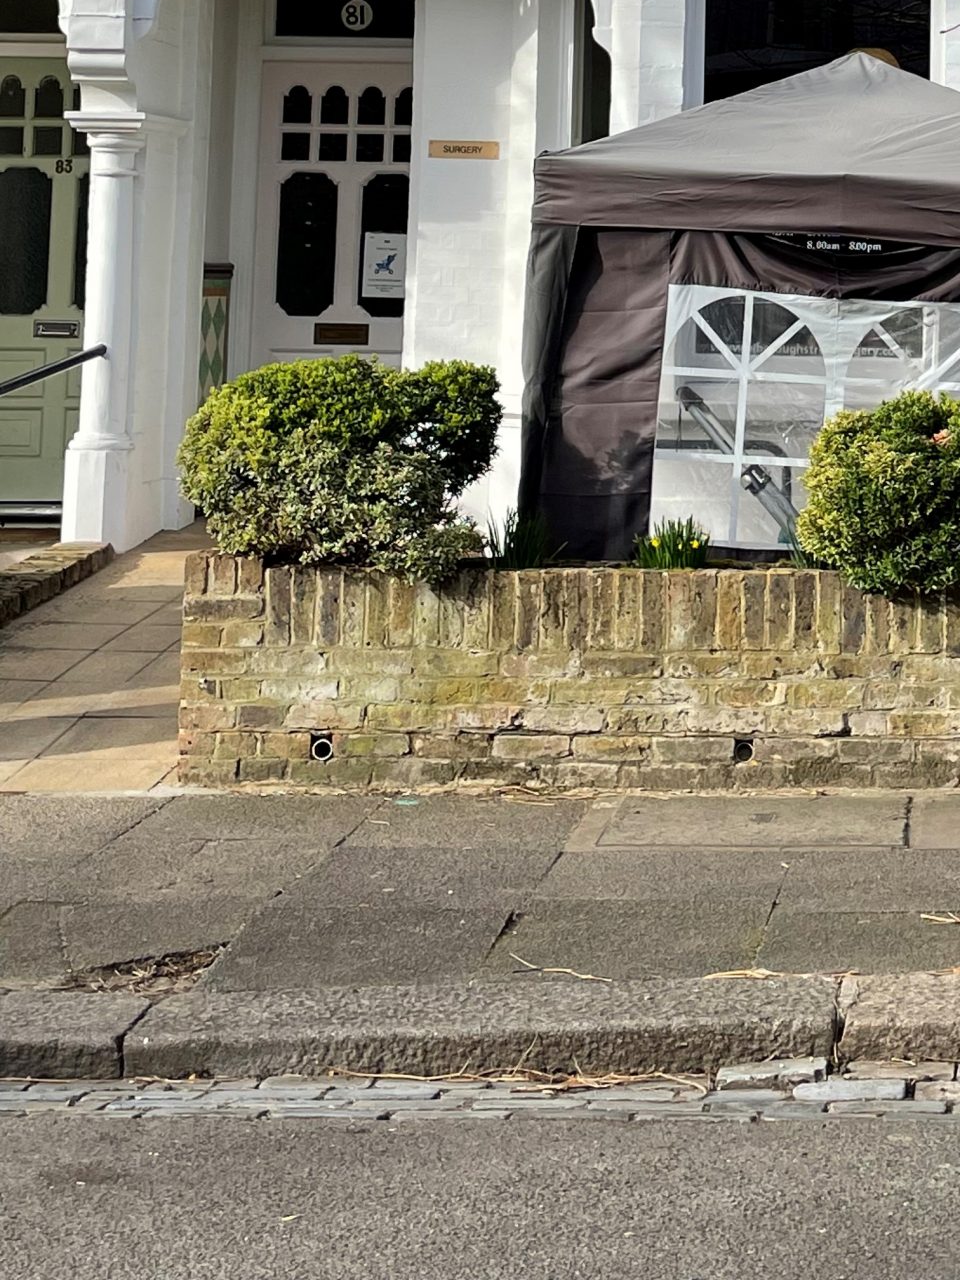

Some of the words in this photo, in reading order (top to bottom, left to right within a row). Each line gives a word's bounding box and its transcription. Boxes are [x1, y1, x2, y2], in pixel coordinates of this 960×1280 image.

[346, 5, 365, 25] 81
[443, 145, 482, 154] SURGERY
[56, 159, 72, 174] 83
